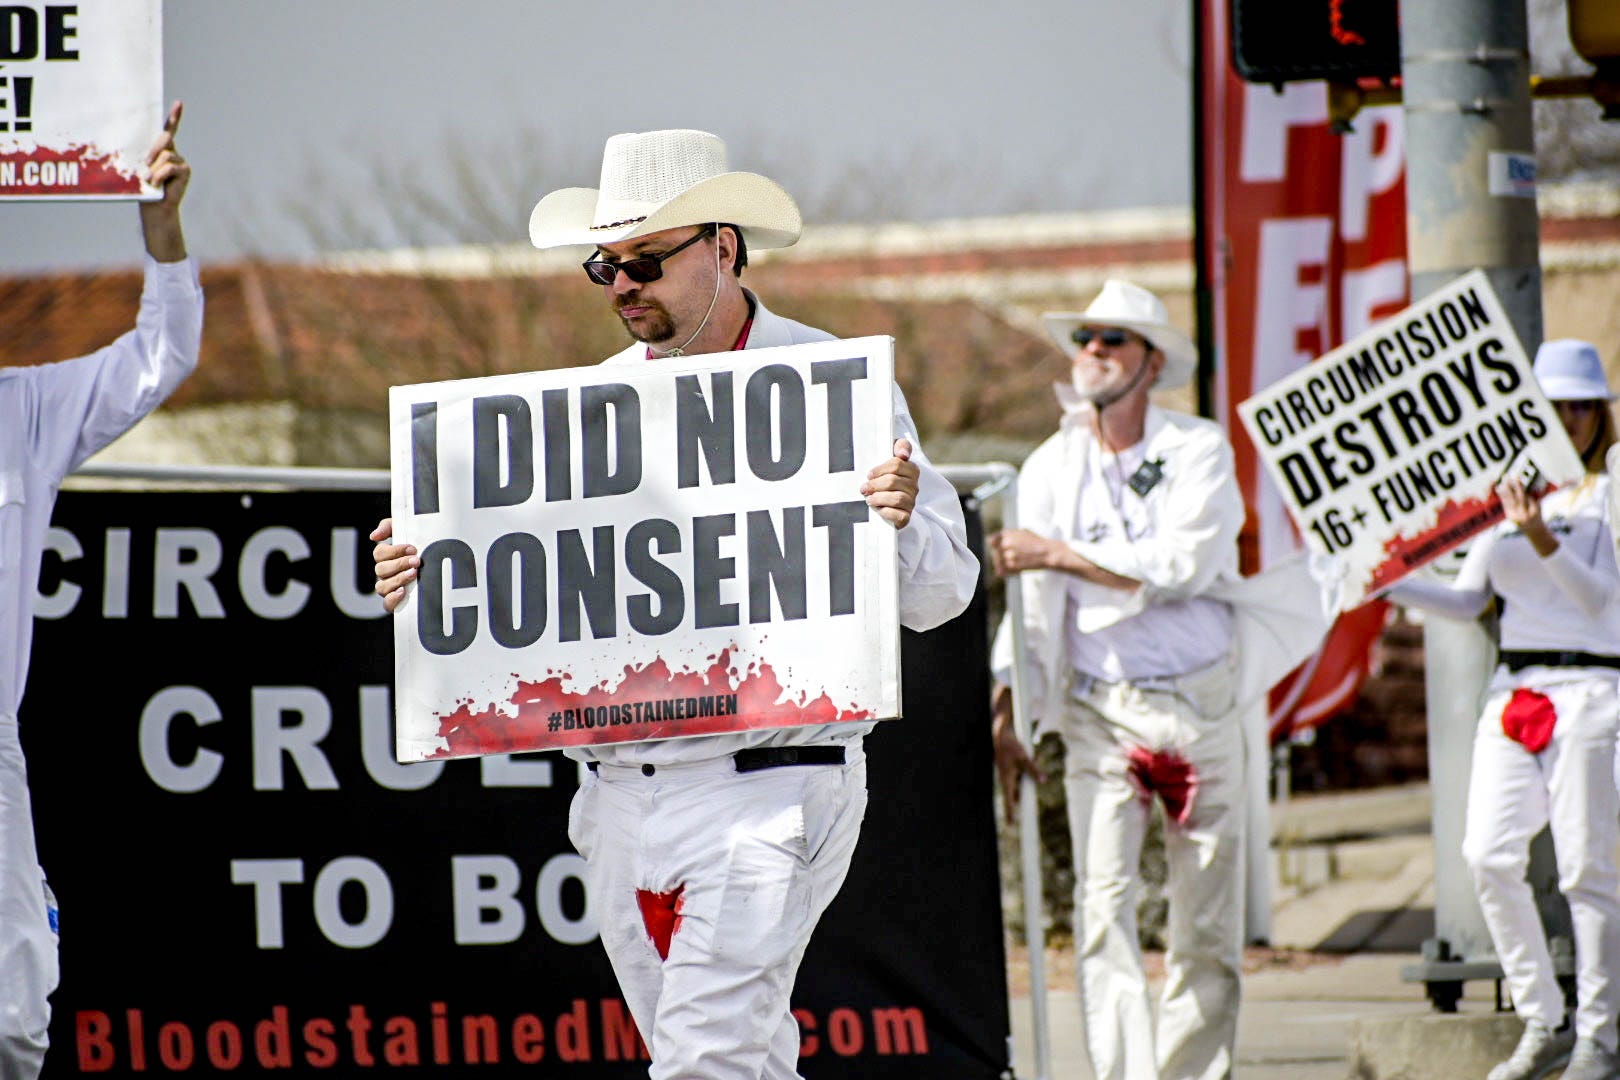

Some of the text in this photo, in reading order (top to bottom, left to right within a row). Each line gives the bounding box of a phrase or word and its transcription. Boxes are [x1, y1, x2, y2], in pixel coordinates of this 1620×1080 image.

[0, 160, 79, 187] N.COM
[411, 356, 868, 516] I DID NOT
[1255, 288, 1490, 446] CIRCUMCISION
[1279, 339, 1522, 508] DESTROYS
[1310, 504, 1368, 555] 16+
[1371, 400, 1548, 522] FUNCTIONS
[33, 526, 391, 620] CIRCU
[416, 501, 870, 656] CONSENT
[547, 693, 738, 732] #BLOODSTAINEDMEN
[230, 854, 601, 949] TO BO
